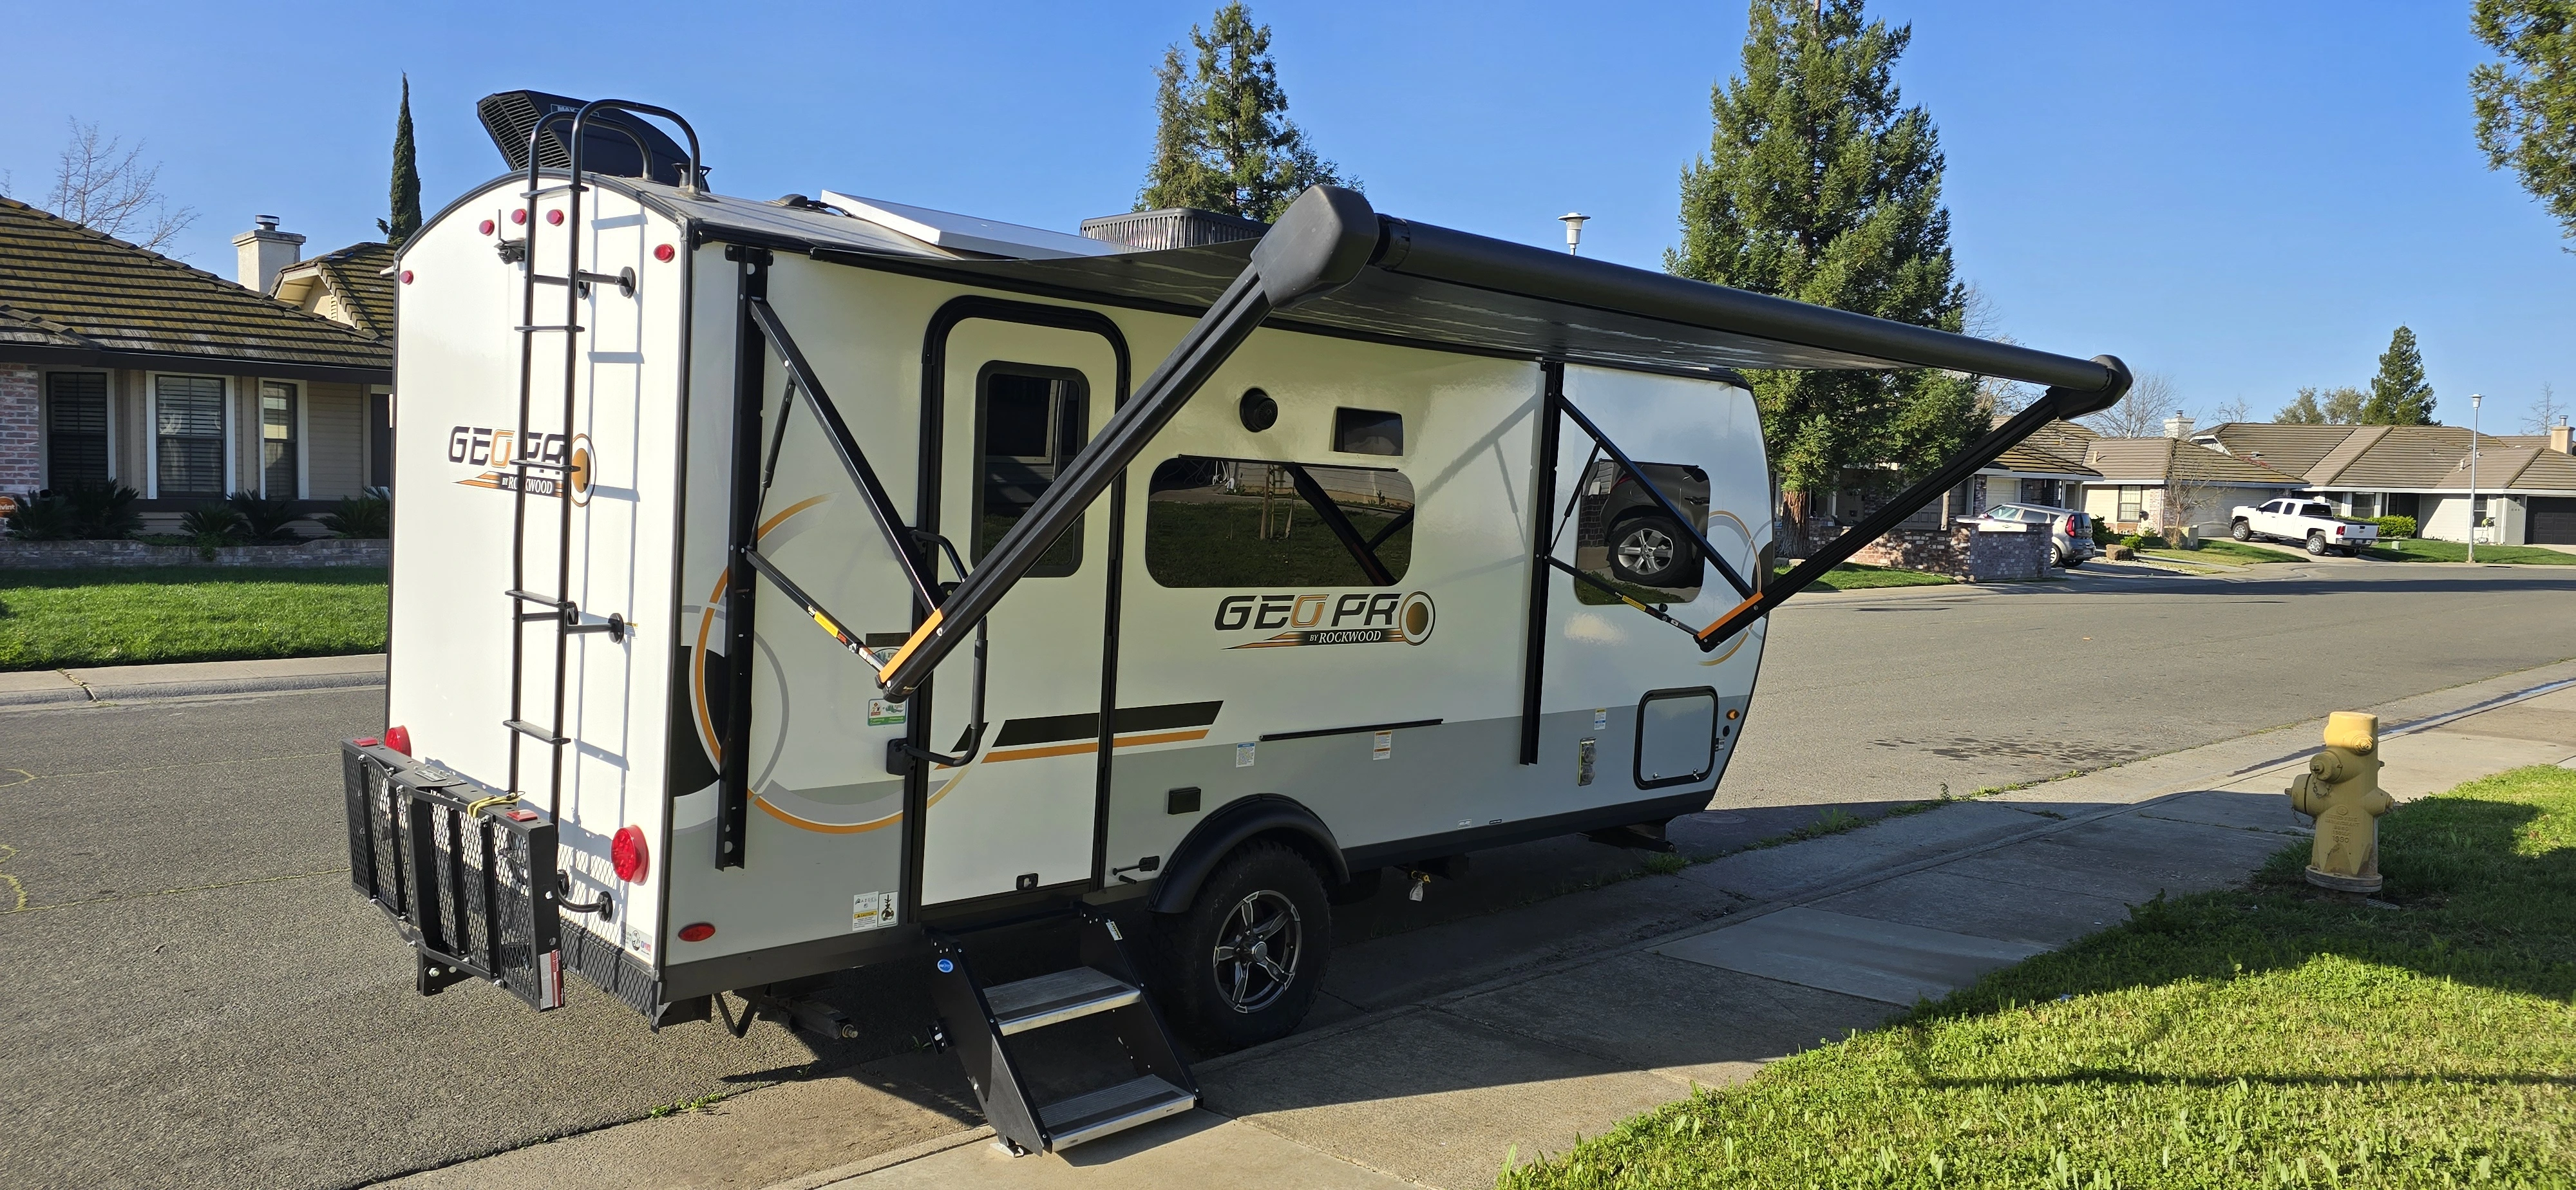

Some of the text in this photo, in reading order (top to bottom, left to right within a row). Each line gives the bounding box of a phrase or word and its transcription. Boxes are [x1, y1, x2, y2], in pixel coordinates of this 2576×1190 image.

[448, 426, 515, 468] GEO
[502, 477, 553, 494] BY ROKWOOD
[1214, 594, 1329, 630] GEO
[1318, 630, 1381, 643] ROCKWOOD
